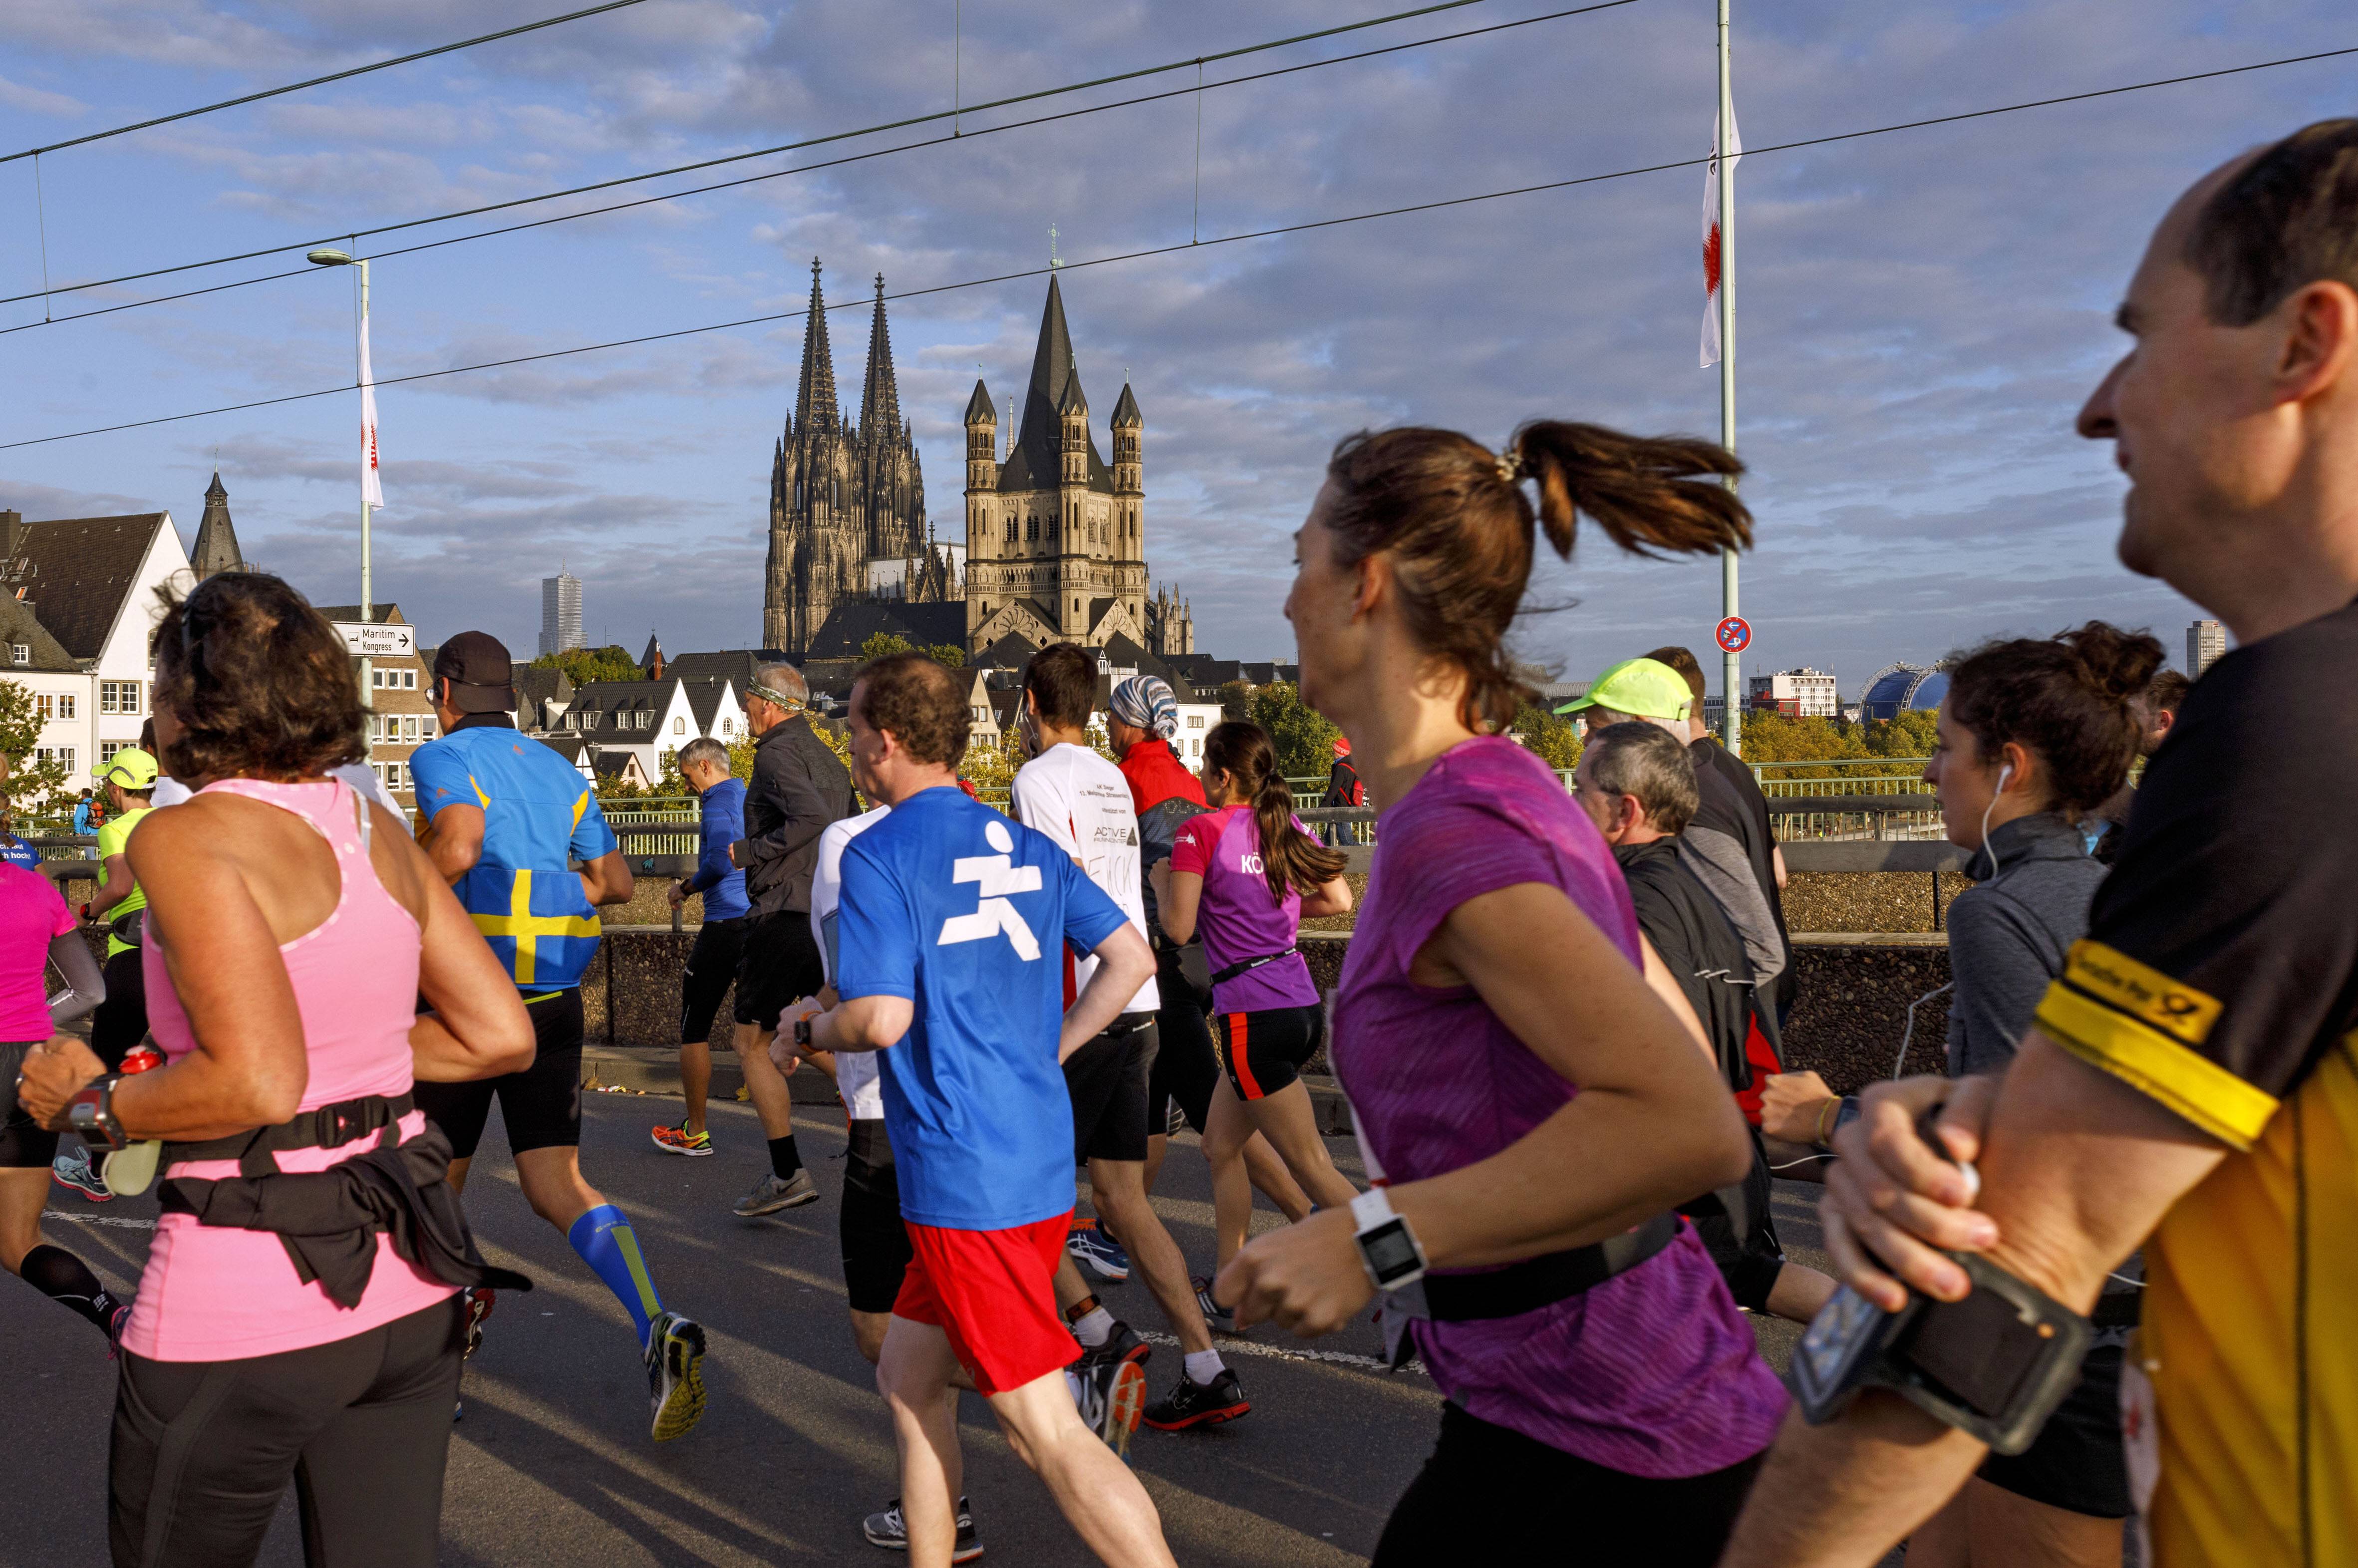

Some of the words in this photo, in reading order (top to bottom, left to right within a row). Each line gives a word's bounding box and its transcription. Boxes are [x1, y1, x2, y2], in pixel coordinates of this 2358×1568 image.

[362, 628, 395, 639] Maritim
[363, 641, 392, 653] Kongress
[1095, 827, 1126, 837] ACTIVE
